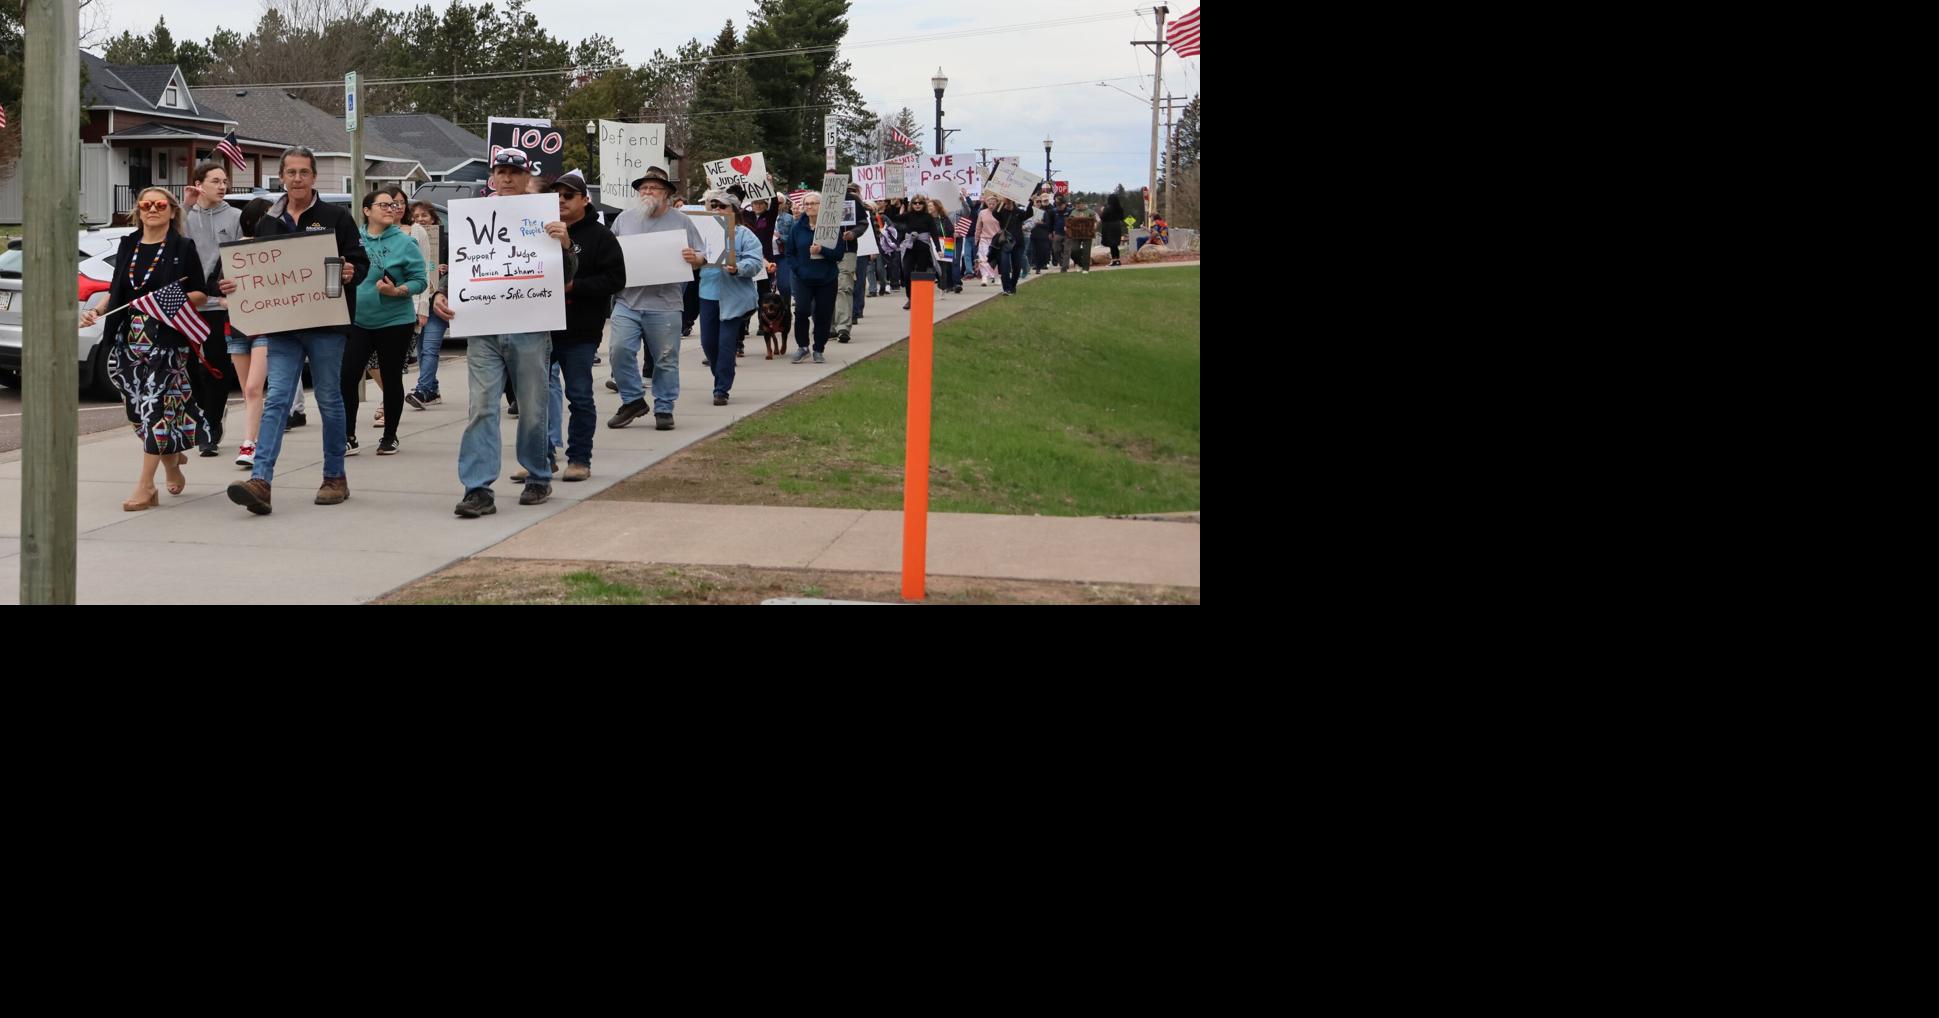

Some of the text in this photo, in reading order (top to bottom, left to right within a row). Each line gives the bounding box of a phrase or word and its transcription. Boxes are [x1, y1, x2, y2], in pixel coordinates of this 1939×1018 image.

[512, 127, 563, 154] 100
[602, 124, 658, 146] Defend
[827, 132, 835, 145] 15
[616, 152, 642, 169] the
[706, 161, 727, 175] WE
[930, 155, 953, 167] WE
[716, 174, 748, 187] JUDGE
[857, 167, 873, 181] NO
[466, 210, 511, 245] We
[232, 249, 282, 269] STOP
[507, 245, 538, 264] Judge
[235, 268, 313, 291] TRUMP
